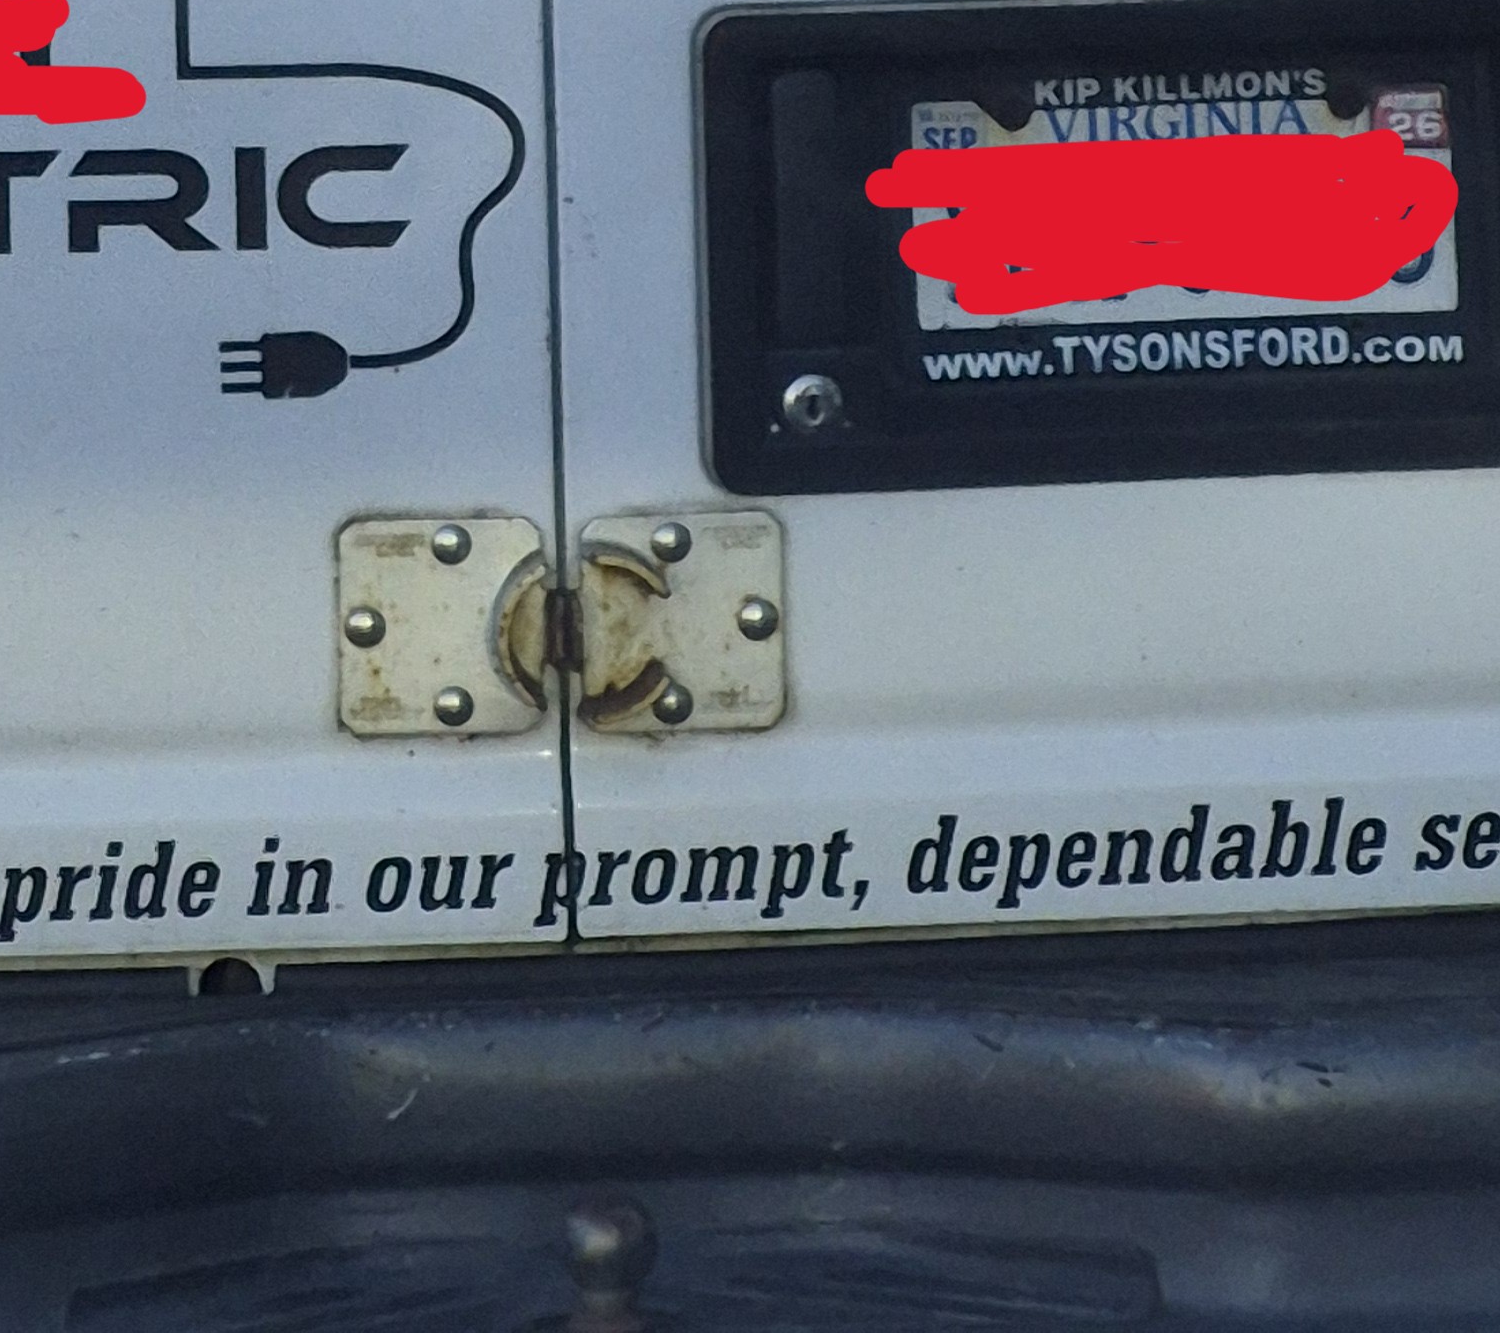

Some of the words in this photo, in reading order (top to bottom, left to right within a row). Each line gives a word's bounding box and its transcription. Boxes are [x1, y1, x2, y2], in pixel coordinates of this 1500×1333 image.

[1034, 77, 1101, 106] KIP
[1113, 68, 1327, 104] KILLMON'S
[1046, 98, 1312, 144] VIRGINIA
[1389, 110, 1444, 140] 26
[246, 837, 333, 916] in
[365, 853, 515, 913] our
[533, 829, 870, 927] prompt,
[906, 796, 1388, 910] dependable
[1414, 812, 1500, 872] se
